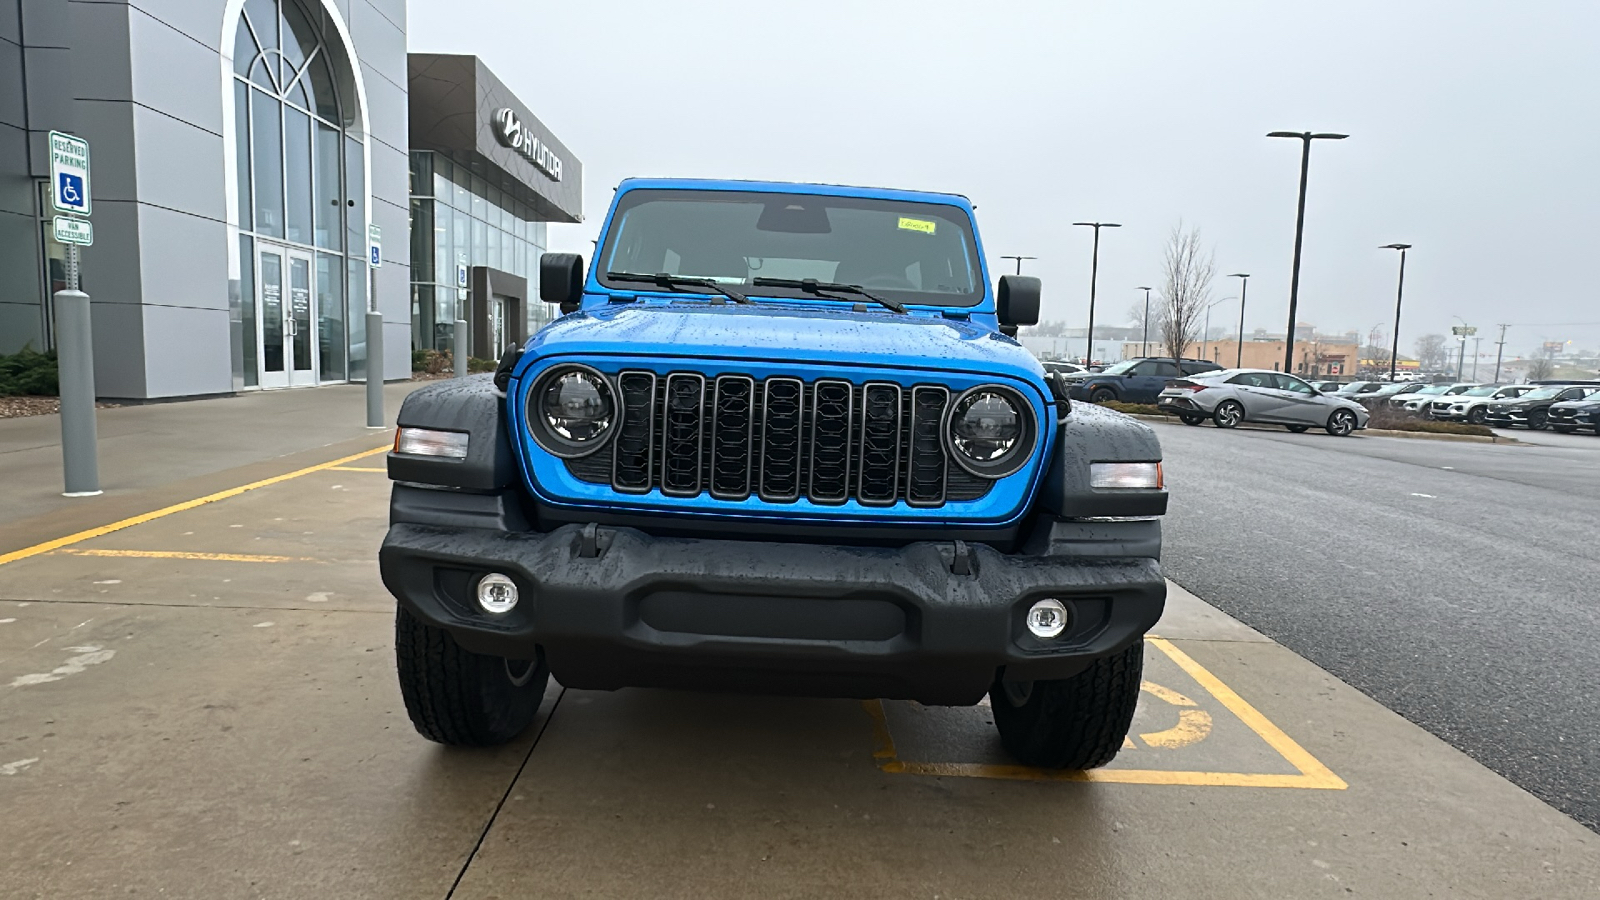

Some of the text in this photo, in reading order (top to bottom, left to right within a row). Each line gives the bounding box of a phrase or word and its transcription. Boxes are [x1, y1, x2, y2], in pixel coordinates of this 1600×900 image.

[54, 140, 85, 157] RESERVED
[525, 128, 562, 181] HYUNDAI
[54, 152, 86, 170] PARKING
[58, 230, 89, 240] ACCESSIBLE
